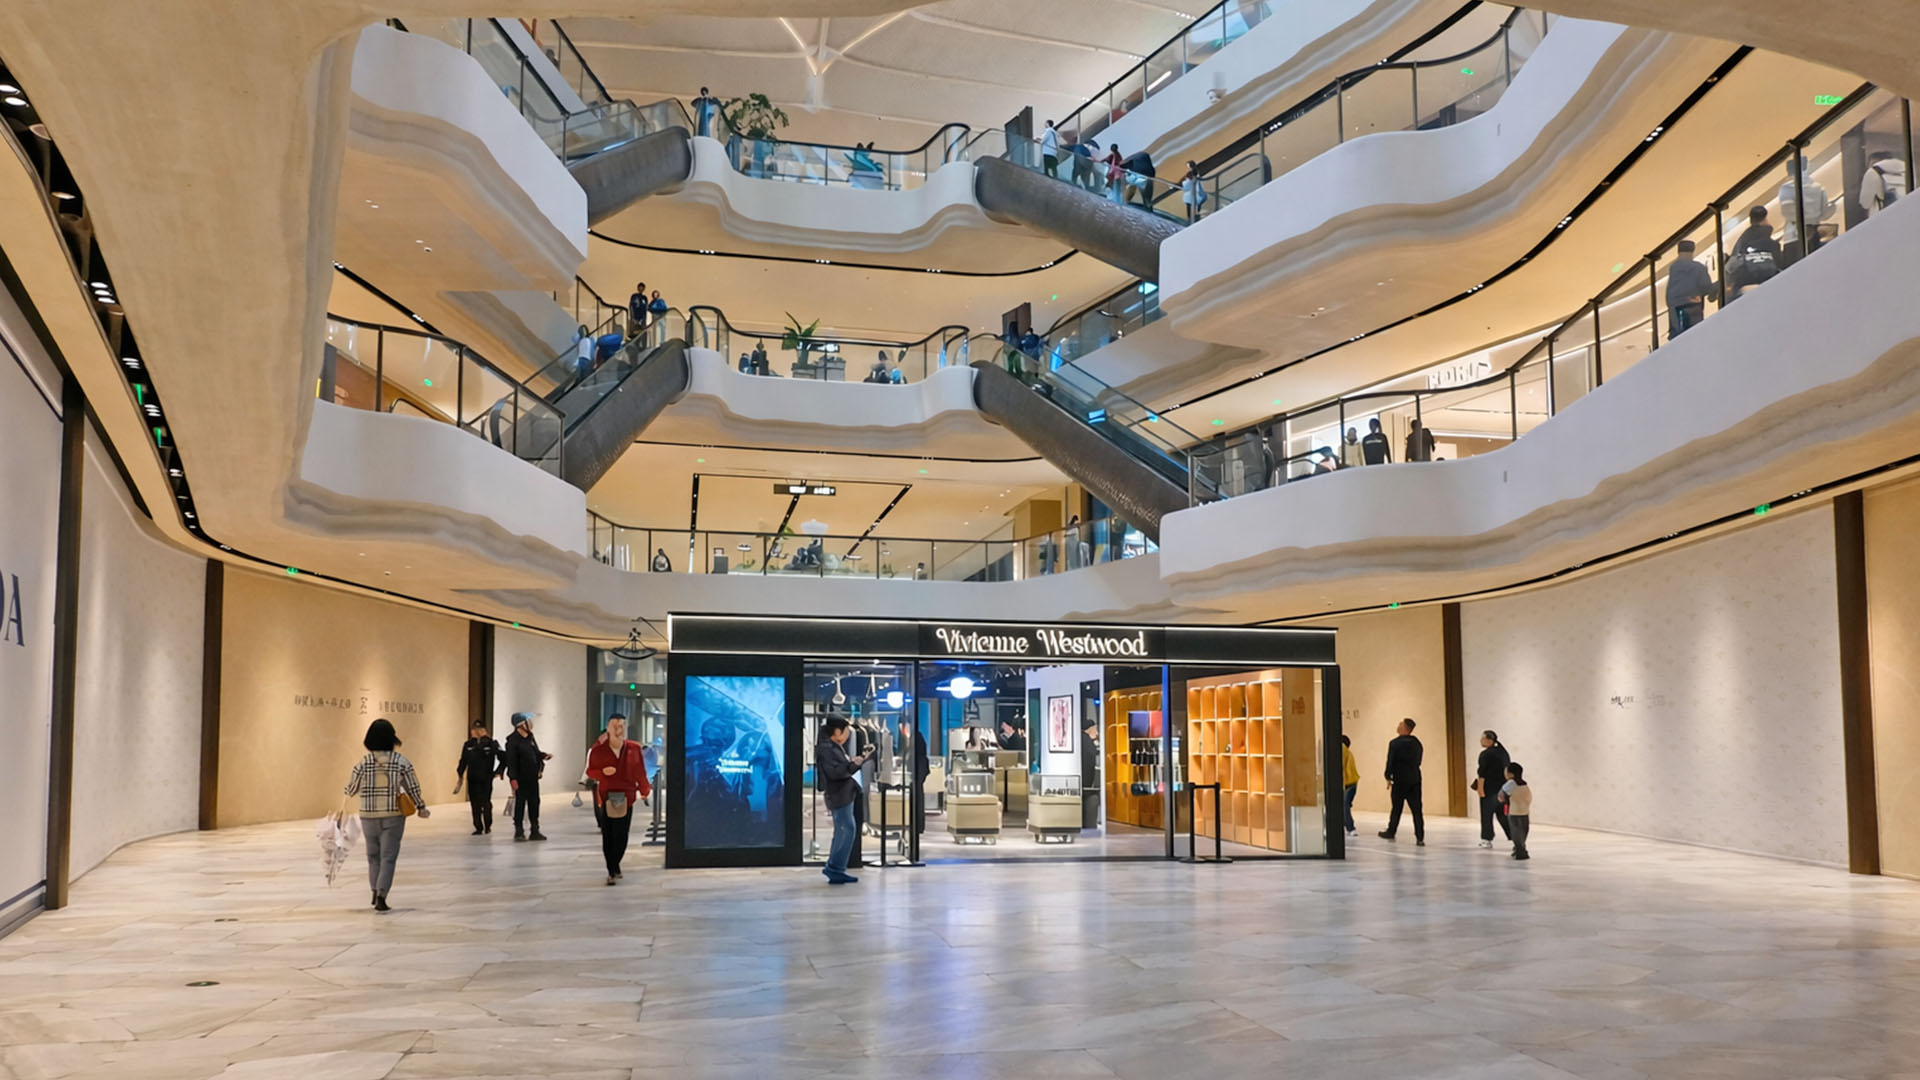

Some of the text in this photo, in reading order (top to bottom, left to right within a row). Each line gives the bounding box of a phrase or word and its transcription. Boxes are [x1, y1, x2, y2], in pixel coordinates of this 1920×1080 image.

[0, 569, 25, 647] A
[936, 627, 1148, 656] Vivienne Westwood
